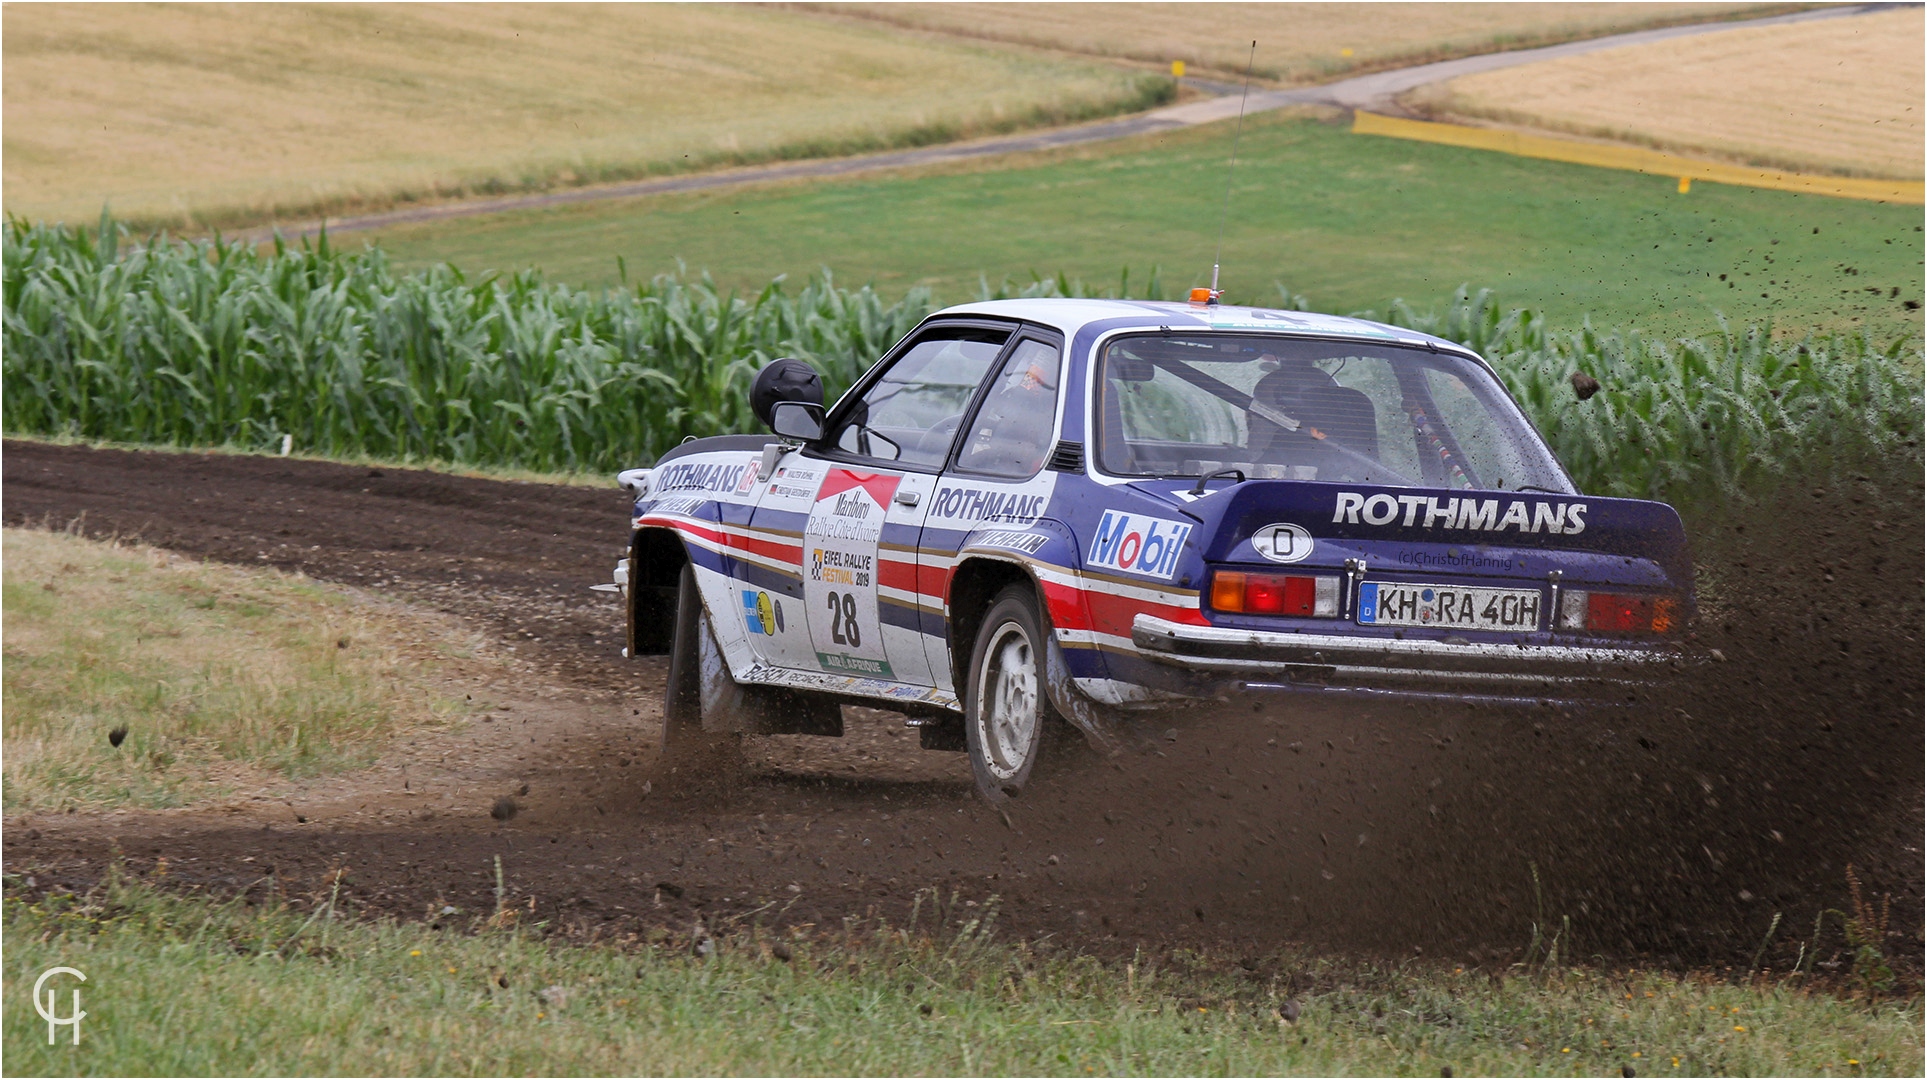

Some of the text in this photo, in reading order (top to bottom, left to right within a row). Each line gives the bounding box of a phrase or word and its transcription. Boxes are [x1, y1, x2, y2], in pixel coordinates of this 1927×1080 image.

[655, 464, 744, 493] ROTHMANS
[653, 498, 705, 515] CHELIN
[833, 491, 870, 519] Marlboro
[931, 488, 1044, 524] ROTHMANS
[1332, 492, 1587, 535] ROTHMANS
[806, 516, 834, 542] Rallye
[1272, 528, 1294, 556] D
[1090, 513, 1189, 575] Mobil
[824, 550, 871, 570] EIFEL RALLYE
[822, 567, 869, 587] FESTIVAL 2019
[828, 591, 861, 648] 28
[1379, 589, 1538, 626] KH RA 40H
[742, 664, 790, 682] BOSCH
[826, 655, 882, 673] AIR AFRIQUE
